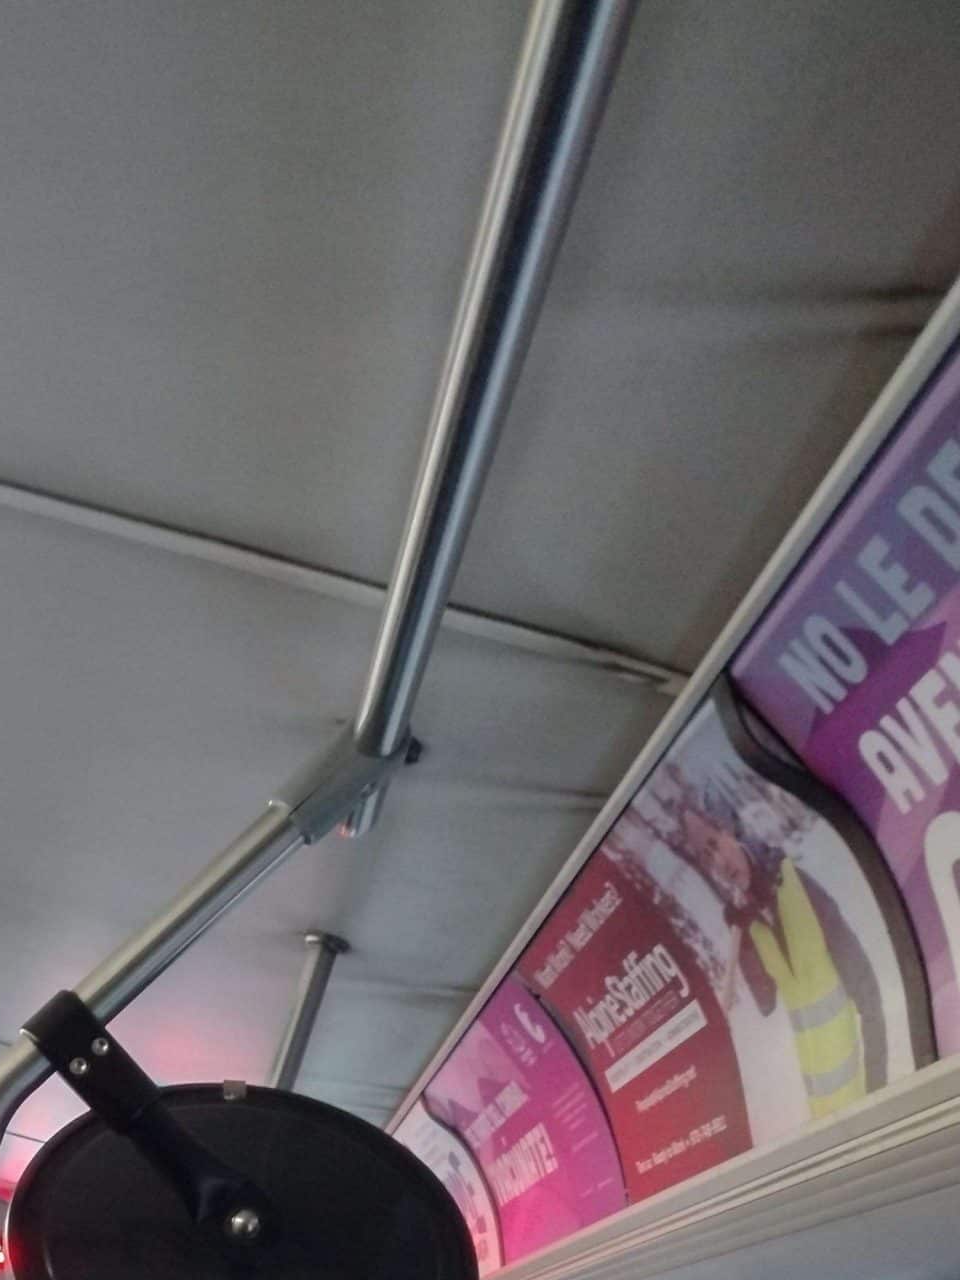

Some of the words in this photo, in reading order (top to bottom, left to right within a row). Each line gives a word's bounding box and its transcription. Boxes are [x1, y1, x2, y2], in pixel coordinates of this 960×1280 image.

[779, 614, 869, 715] NO
[835, 535, 936, 647] LE
[858, 638, 960, 815] AVE
